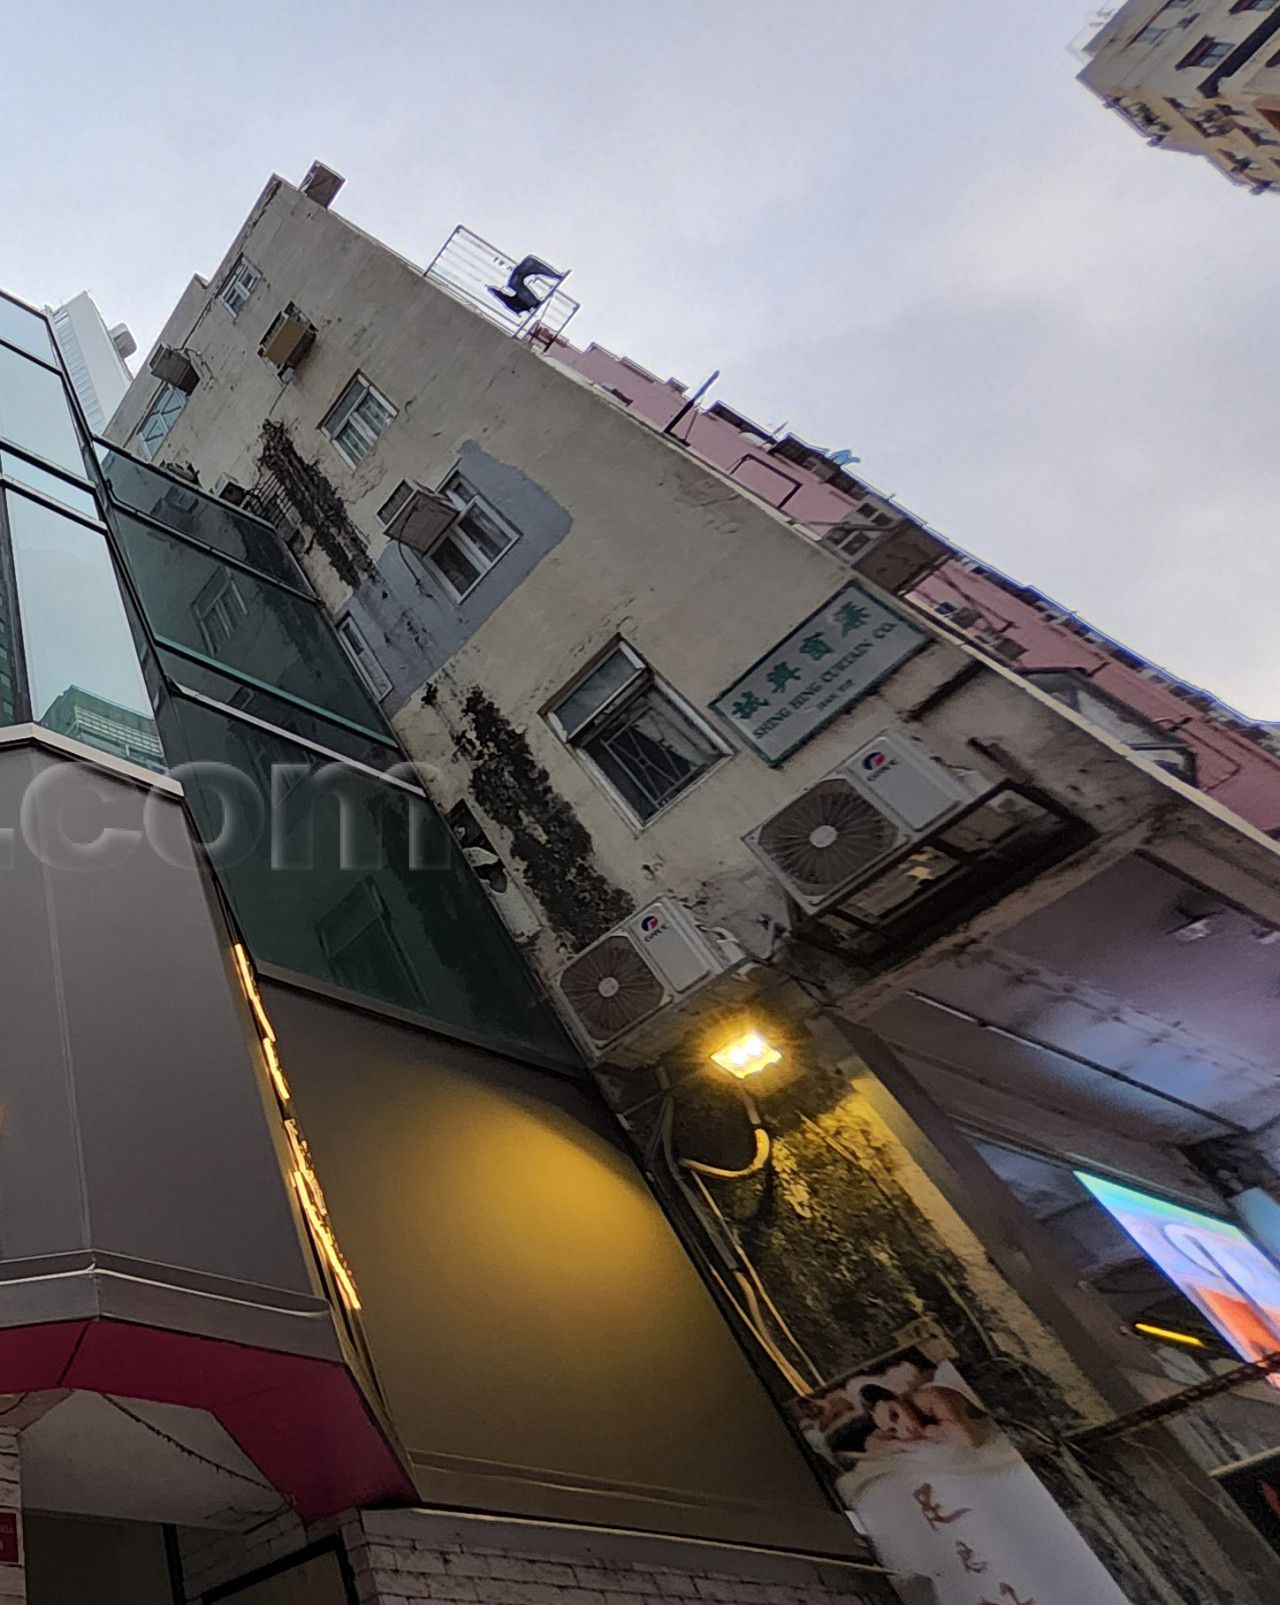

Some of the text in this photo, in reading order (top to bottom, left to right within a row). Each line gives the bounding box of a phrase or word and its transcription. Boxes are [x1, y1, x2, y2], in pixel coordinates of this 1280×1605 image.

[752, 707, 793, 739] SHING
[788, 681, 823, 710] HING
[821, 638, 875, 683] CURTAIN
